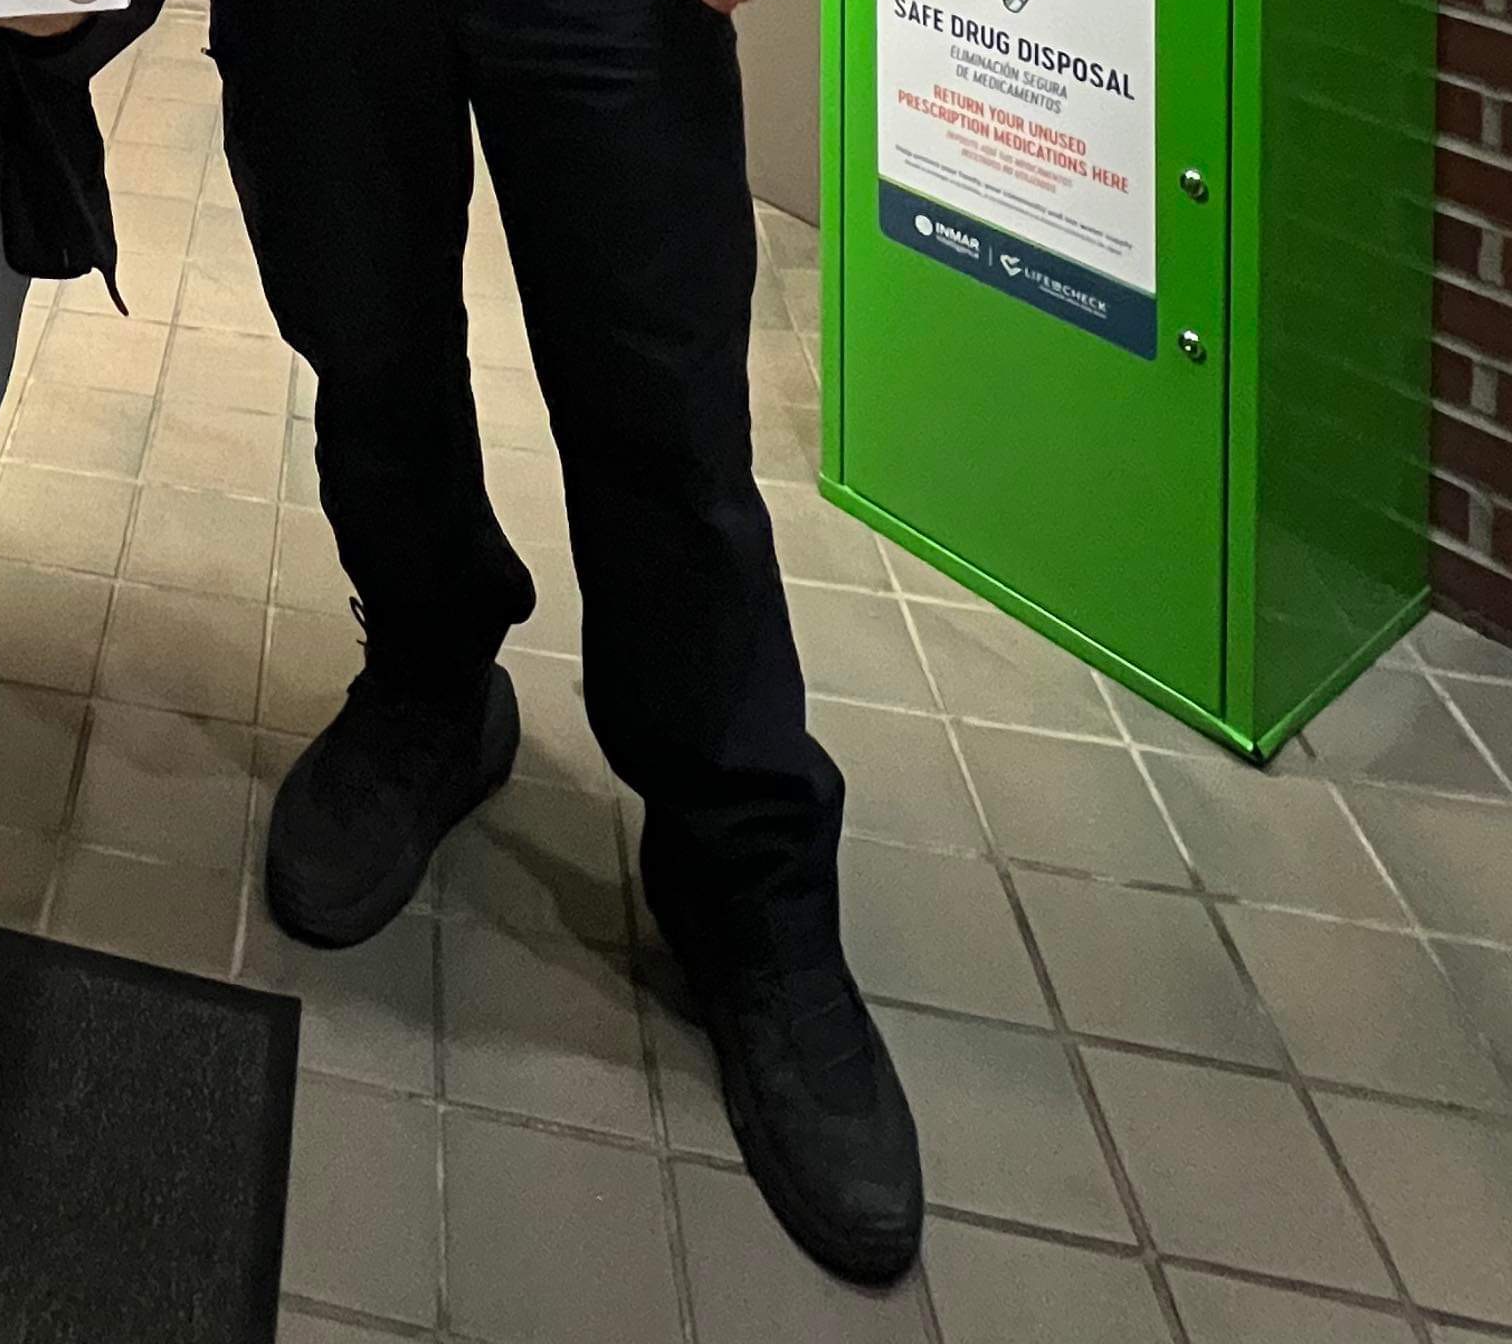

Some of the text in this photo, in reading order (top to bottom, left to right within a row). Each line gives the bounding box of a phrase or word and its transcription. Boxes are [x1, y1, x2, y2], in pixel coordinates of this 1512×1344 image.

[951, 14, 1010, 55] DRUG
[1017, 38, 1136, 101] DISPOSAL
[956, 63, 1062, 114] DE MEDICAMENTOS
[1022, 70, 1068, 100] SEGURA
[898, 88, 990, 139] PRESCRIPTION
[993, 126, 1088, 177] MEDICATIONS
[1091, 164, 1129, 194] HERE
[933, 83, 1087, 157] RETURN YOUR UNUSED
[935, 222, 980, 251] INMAR
